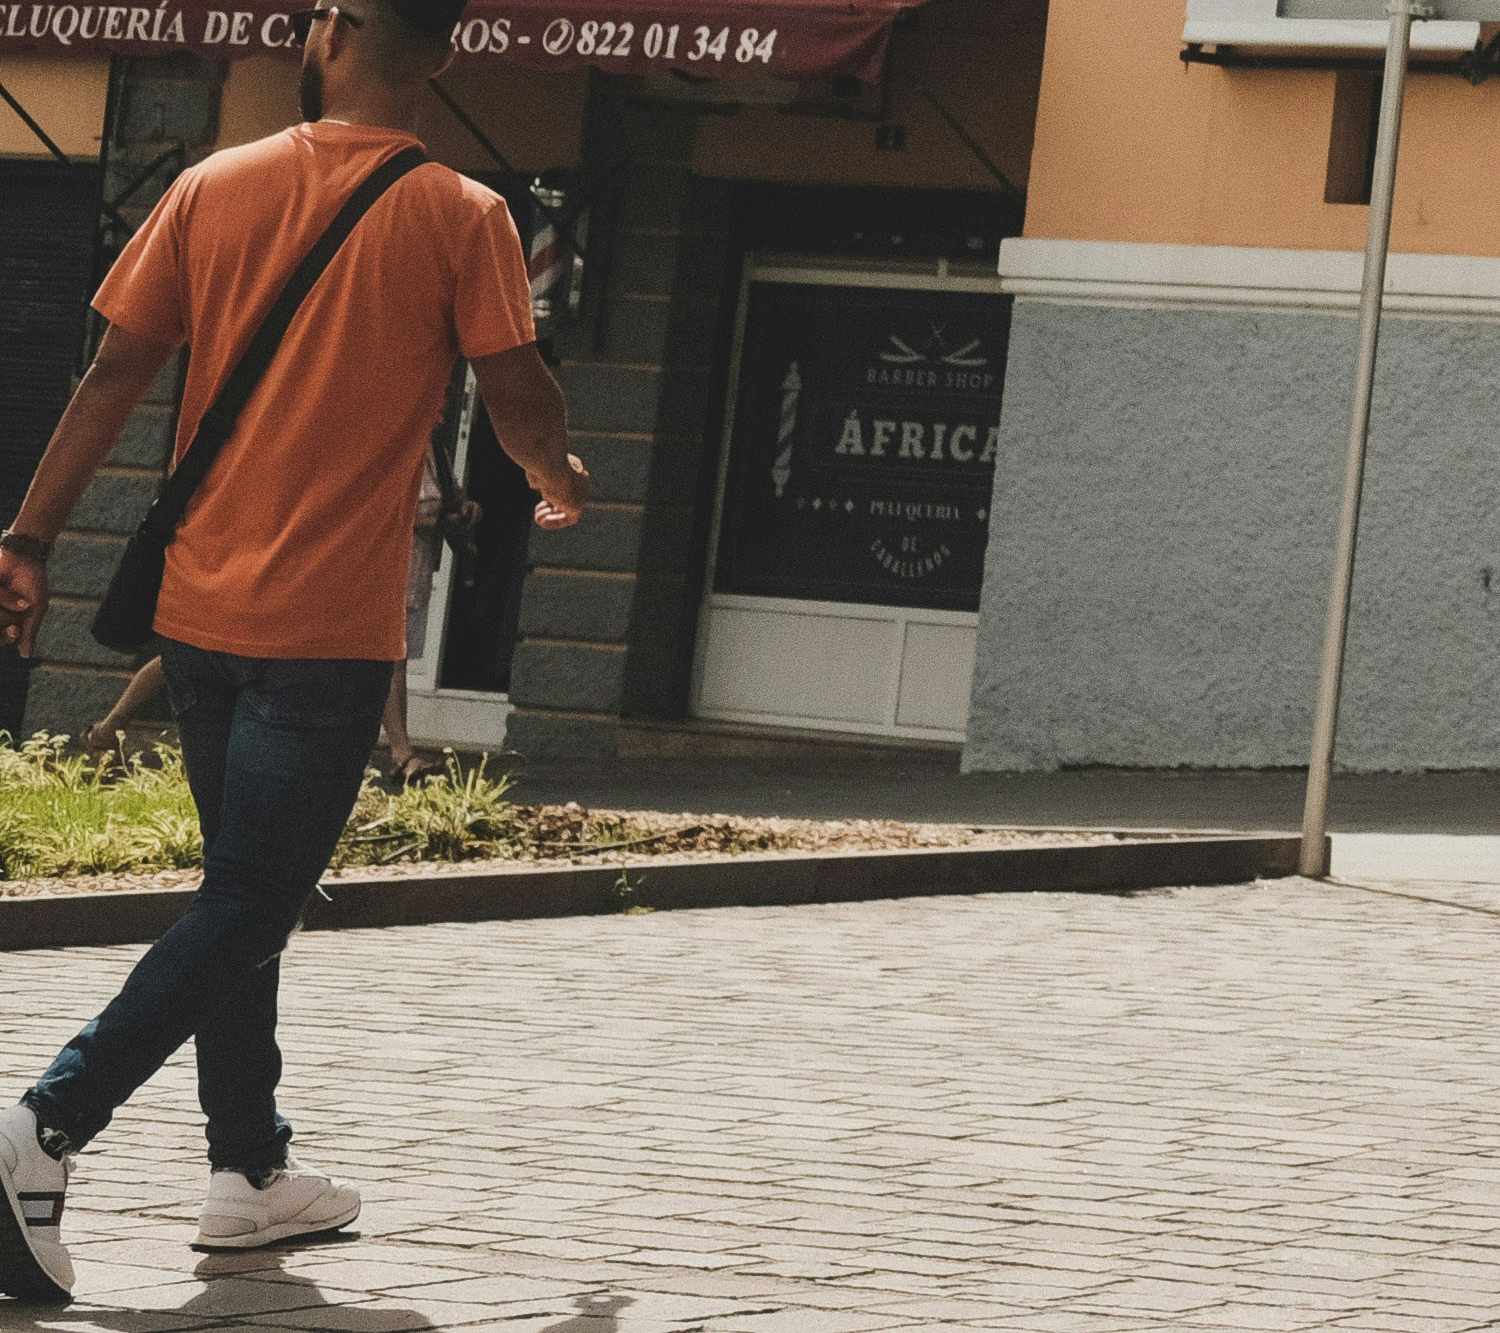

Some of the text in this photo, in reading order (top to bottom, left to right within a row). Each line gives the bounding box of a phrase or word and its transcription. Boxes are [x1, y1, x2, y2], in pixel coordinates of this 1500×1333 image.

[0, 0, 186, 45] LUQUERÍA
[203, 10, 253, 44] DE
[576, 20, 635, 57] 822
[643, 23, 681, 59] 01
[687, 25, 731, 64] 34
[735, 27, 778, 64] 84
[867, 367, 994, 389] BARBER SHOP
